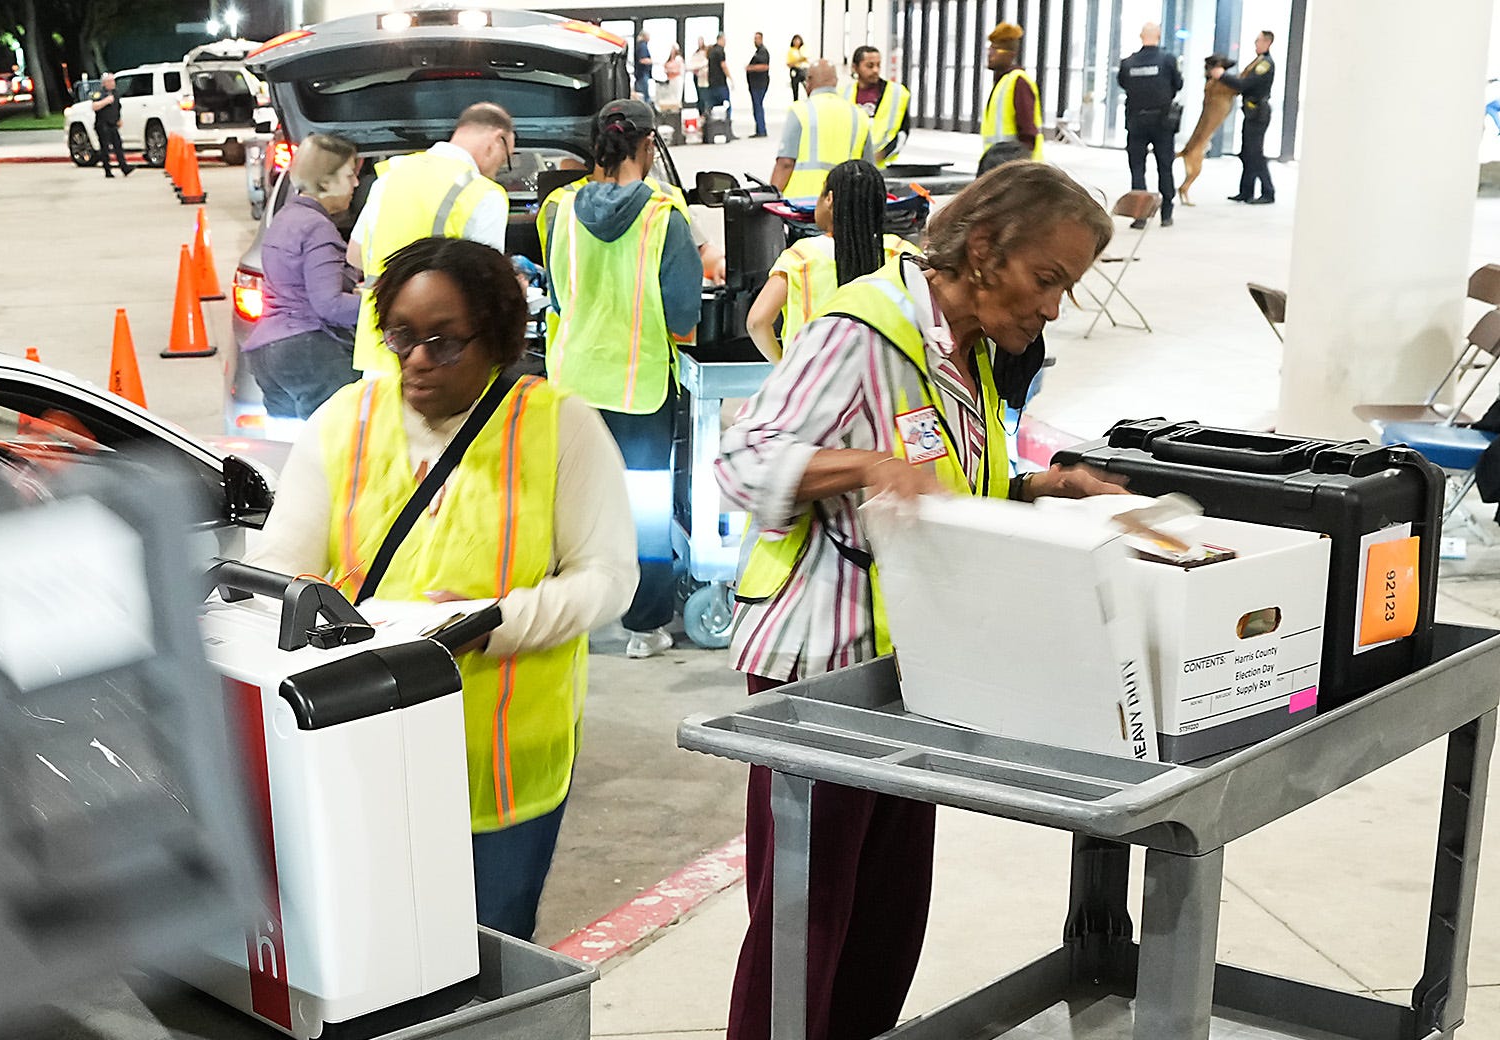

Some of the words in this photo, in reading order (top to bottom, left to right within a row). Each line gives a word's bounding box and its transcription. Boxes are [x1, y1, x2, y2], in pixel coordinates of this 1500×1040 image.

[1385, 570, 1396, 622] 92123
[1183, 655, 1227, 673] CONTENTS:
[1234, 651, 1254, 664] Harris
[1255, 647, 1278, 659] County
[1235, 666, 1261, 681] Election
[1262, 663, 1275, 675] Day
[1235, 682, 1258, 696] Supply
[1259, 679, 1271, 689] Box
